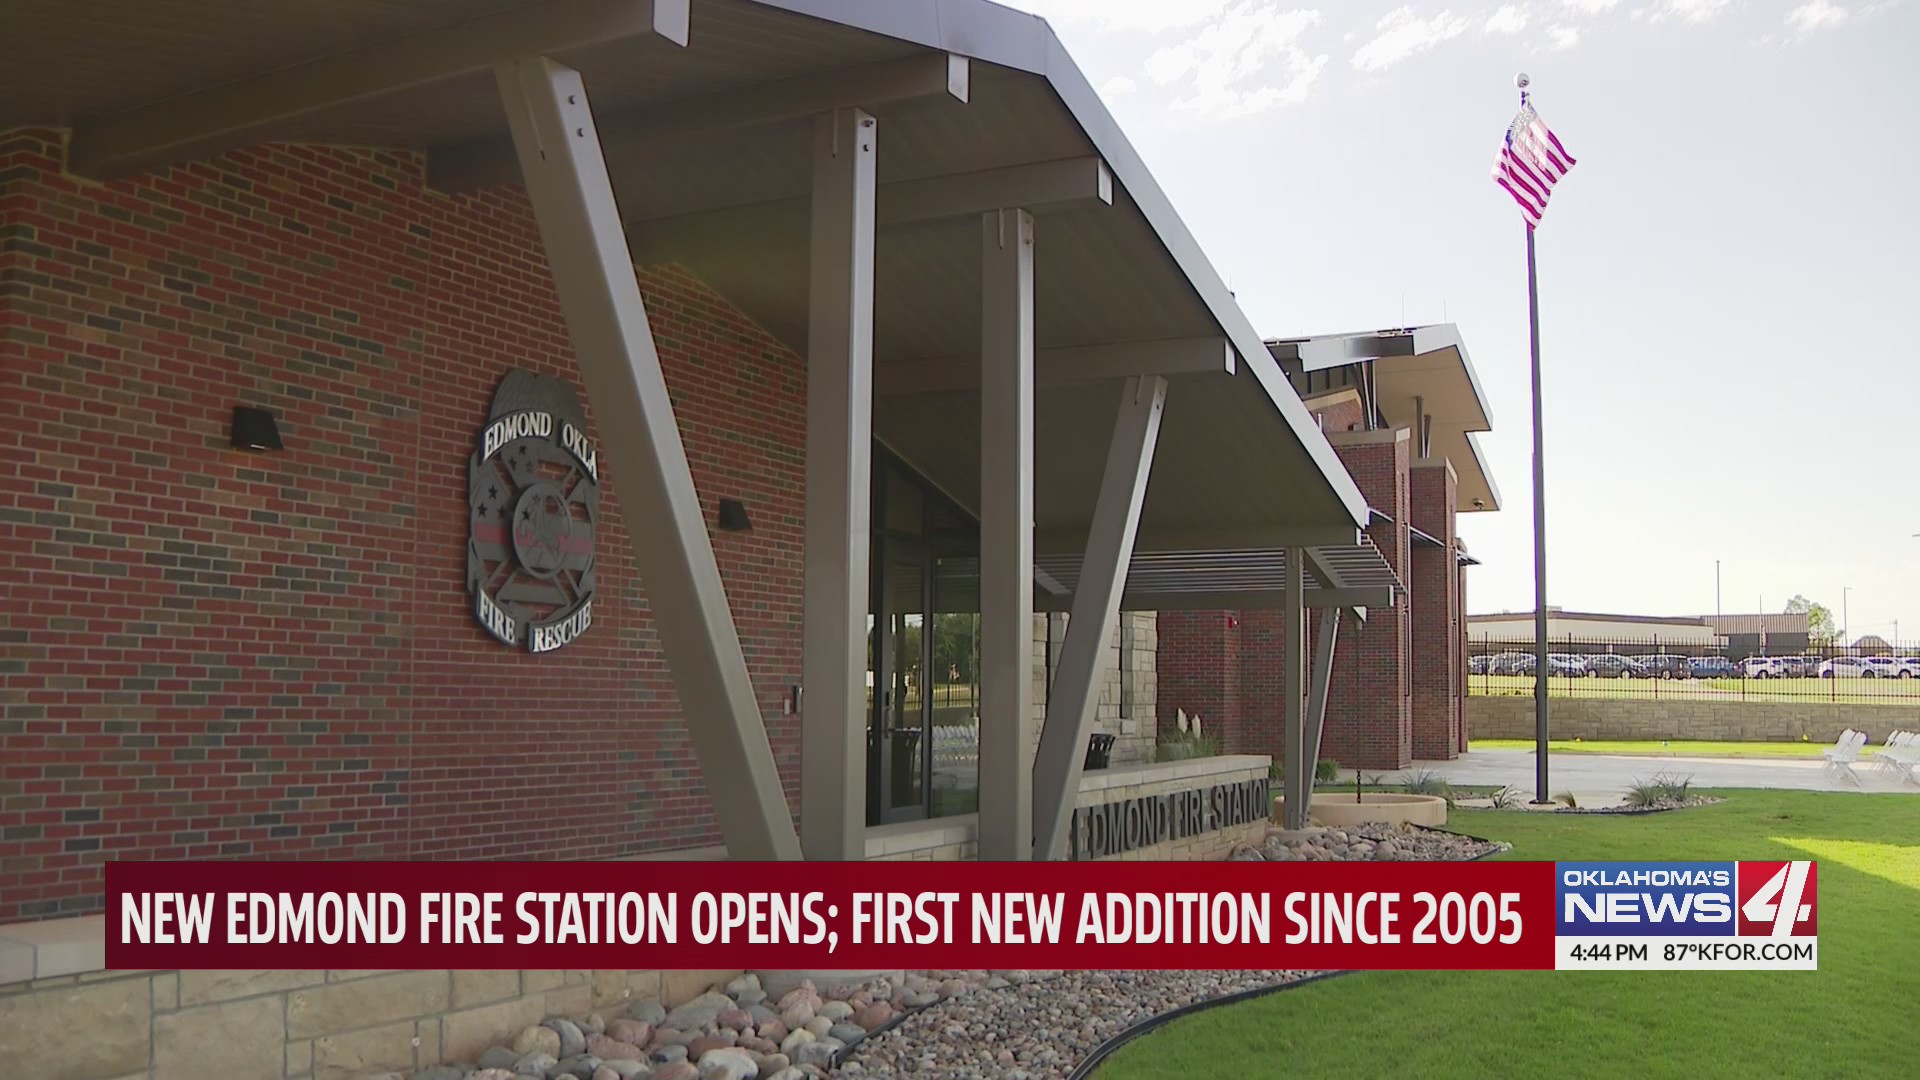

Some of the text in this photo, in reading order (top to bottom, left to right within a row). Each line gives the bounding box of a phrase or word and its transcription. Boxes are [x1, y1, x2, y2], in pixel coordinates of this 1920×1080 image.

[482, 411, 598, 480] EDMOND OKLA
[479, 588, 592, 653] FIRE RESCUE
[1072, 778, 1268, 861] EDMOND FIRE STATION
